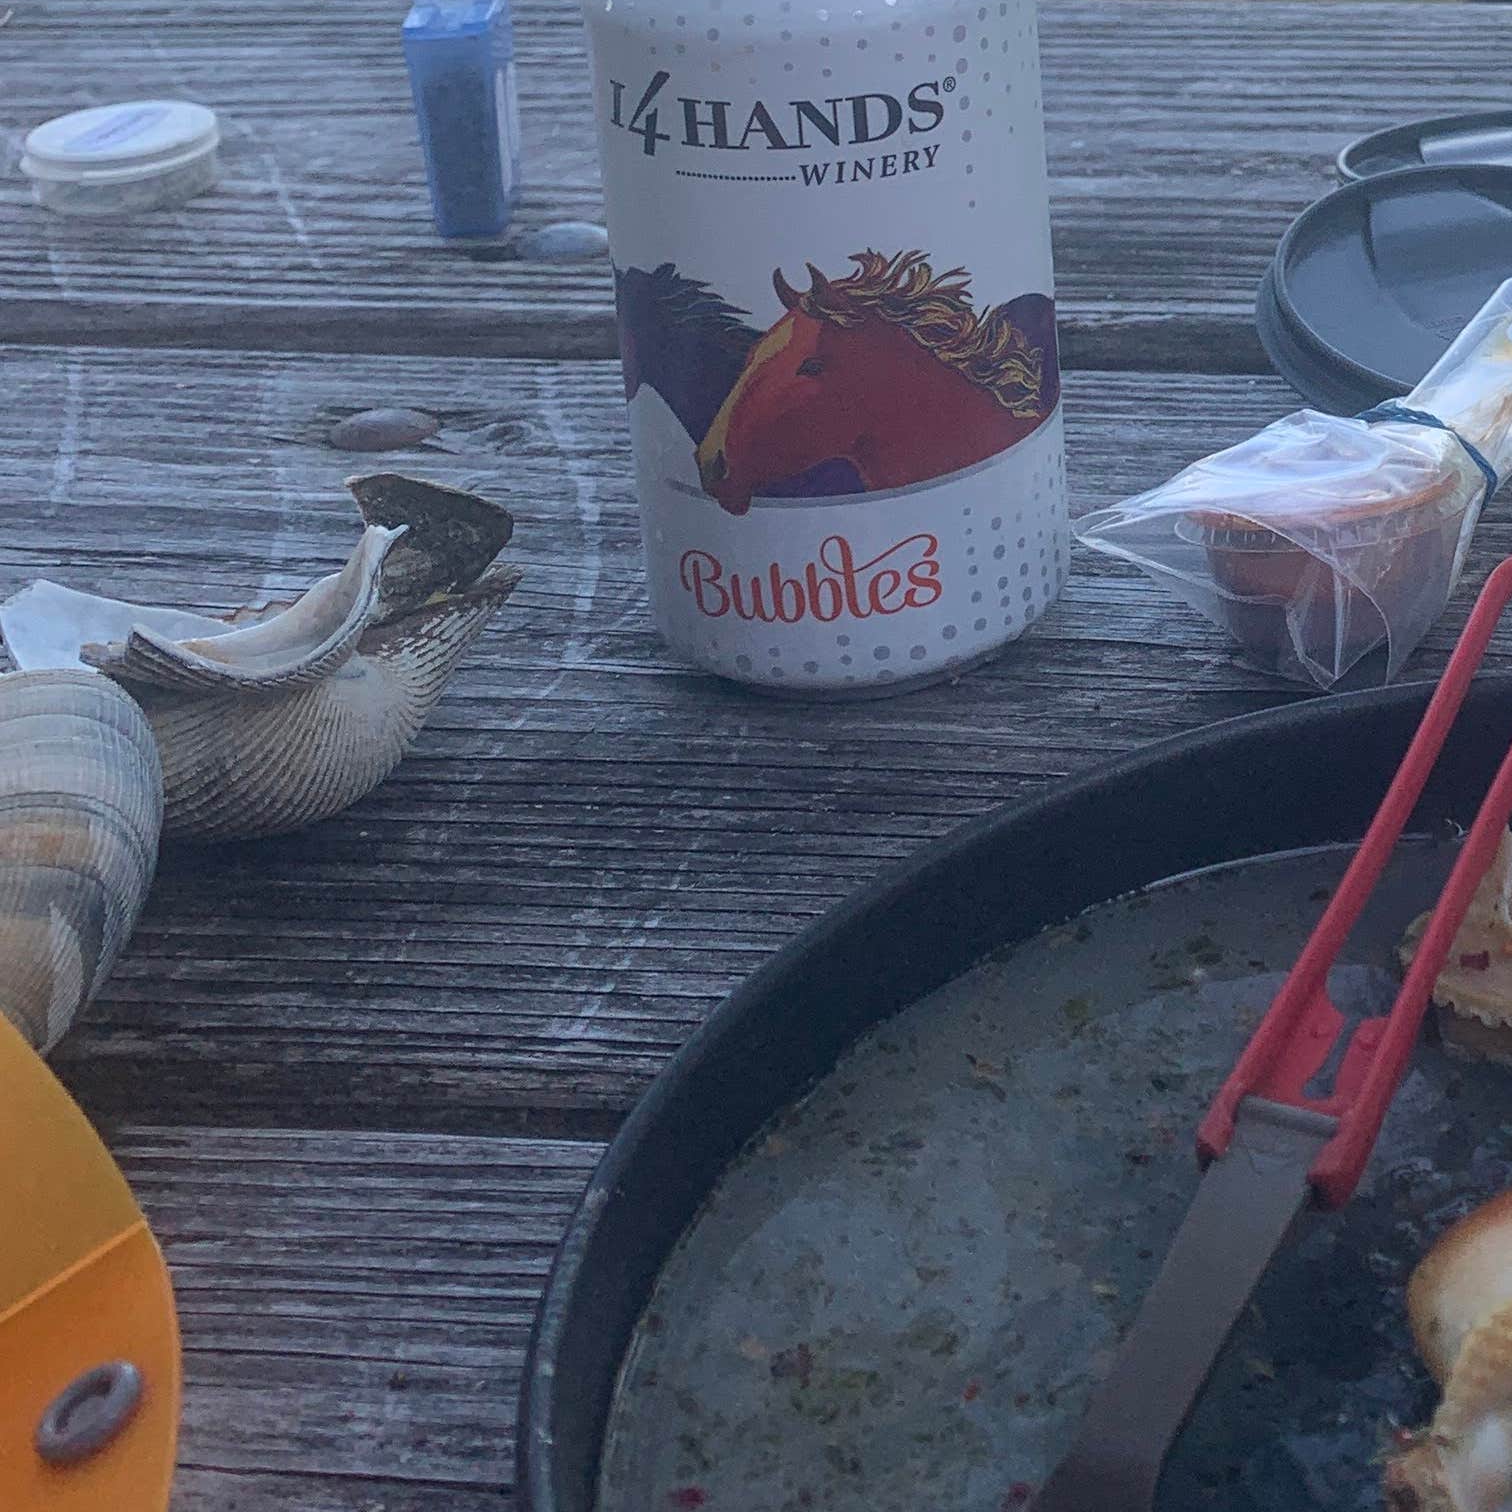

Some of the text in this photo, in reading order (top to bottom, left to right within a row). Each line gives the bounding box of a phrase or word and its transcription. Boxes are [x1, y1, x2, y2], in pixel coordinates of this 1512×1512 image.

[609, 70, 671, 157] 14
[800, 143, 941, 187] WINERY
[678, 533, 943, 624] Bubbles
